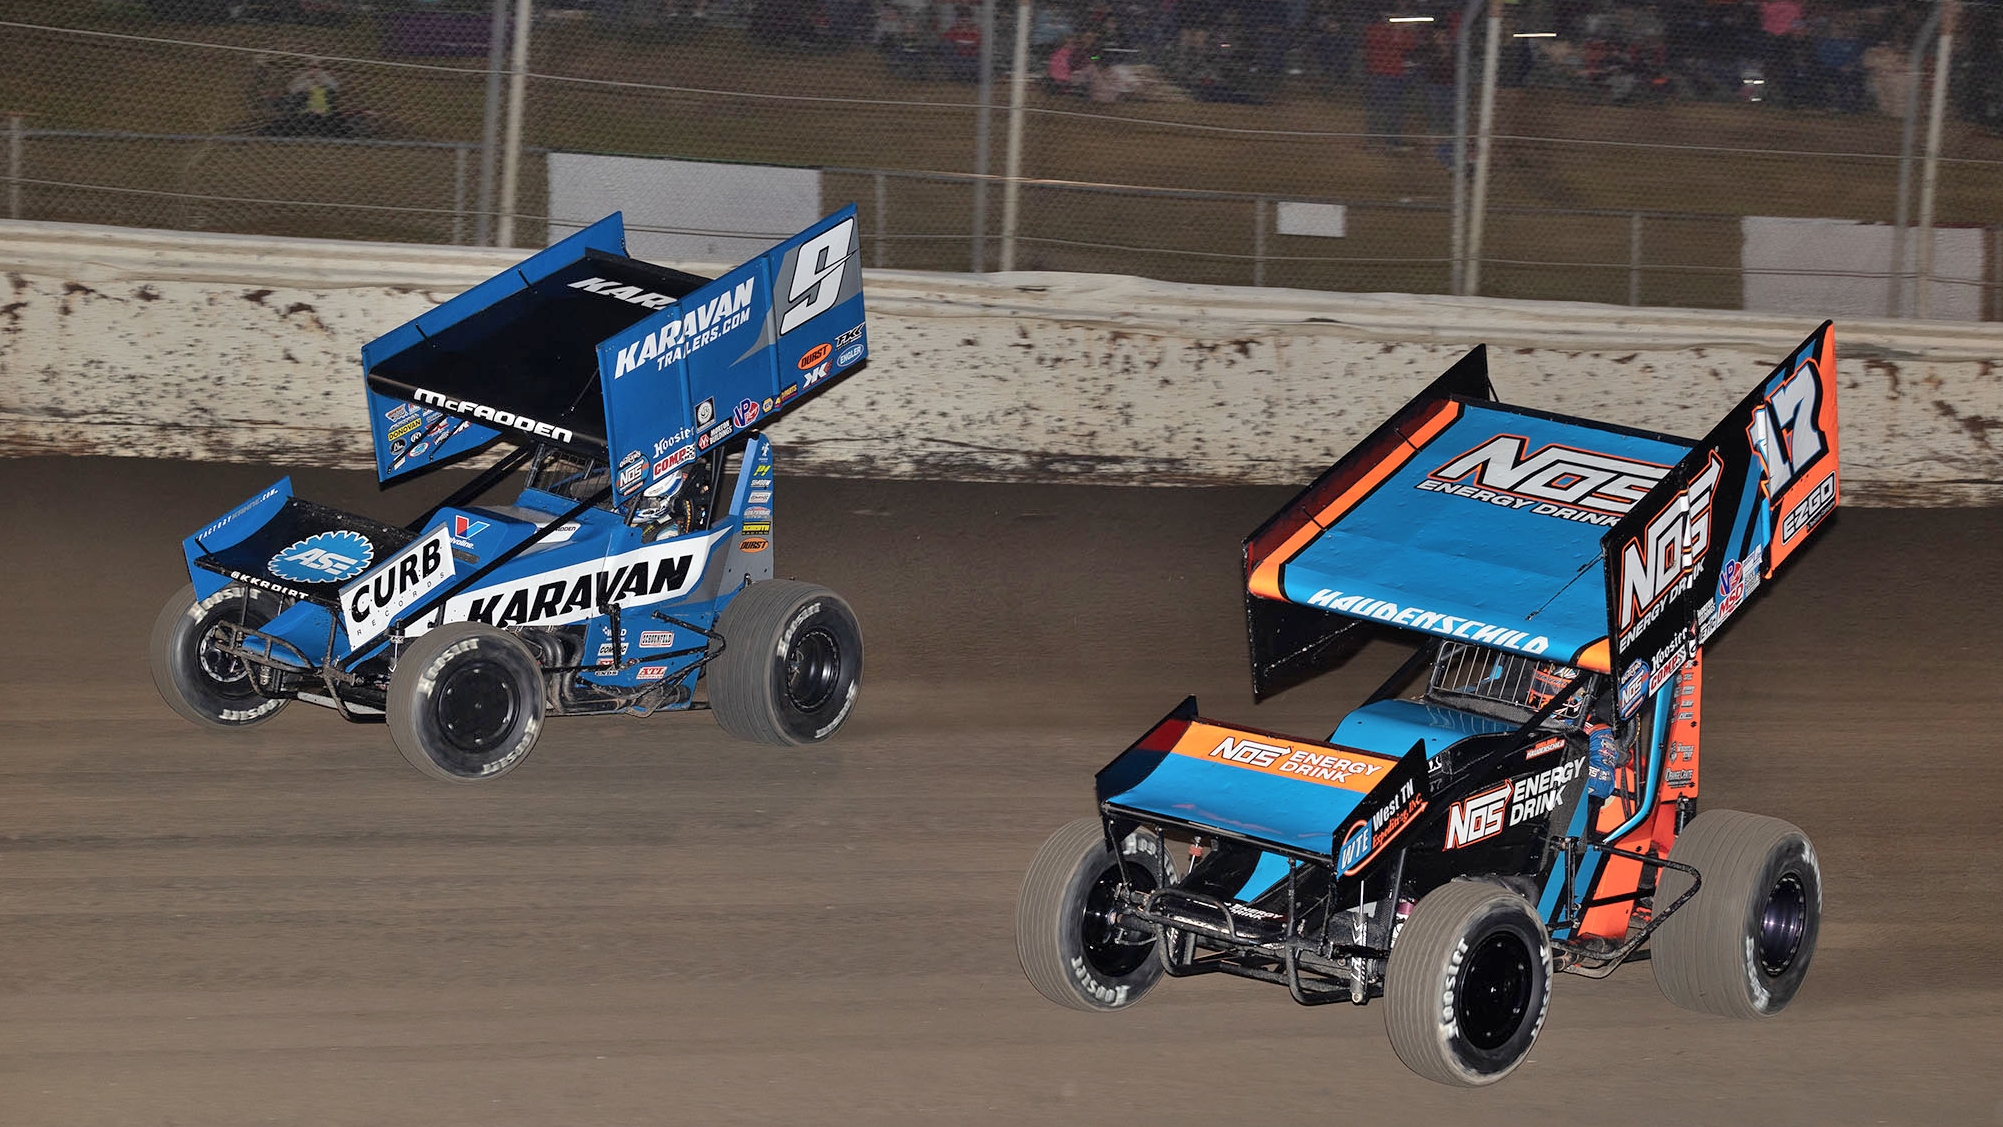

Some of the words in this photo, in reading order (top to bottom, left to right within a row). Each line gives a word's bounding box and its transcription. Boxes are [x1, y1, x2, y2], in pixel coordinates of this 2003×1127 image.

[780, 217, 854, 335] 9
[614, 277, 755, 380] KARAVAN
[657, 307, 750, 371] TRAILERS.COM
[801, 345, 829, 368] DURST
[839, 346, 861, 365] ENGLER
[389, 420, 420, 440] DONOVAN
[413, 388, 573, 444] McFADDEN
[1750, 363, 1822, 498] 17
[653, 426, 694, 459] Hoosier
[654, 447, 686, 477] COMP
[619, 459, 643, 487] NOS
[1438, 437, 1668, 513] NOS
[1416, 480, 1532, 509] ENERGY
[1532, 504, 1621, 527] DRINK
[740, 541, 768, 549] DURST
[1622, 457, 1721, 629] NOS
[230, 571, 309, 600] @KKRDIRT
[351, 538, 441, 623] CURB
[357, 572, 445, 635] RECORDS
[466, 553, 694, 627] KARAVAN
[1719, 583, 1743, 618] MSD
[1307, 588, 1550, 655] HAUDENSCHILD
[1619, 597, 1667, 654] ENERGY
[640, 667, 665, 675] ATL
[1650, 626, 1688, 674] Hoosier
[1650, 654, 1679, 691] COMP
[1621, 669, 1644, 707] NOS
[1209, 736, 1292, 768] NOS
[1290, 750, 1383, 776] ENERGY
[1278, 760, 1352, 783] DRINK
[1513, 757, 1586, 803] ENERGY
[1373, 794, 1400, 831] West
[1401, 778, 1414, 804] TN
[1447, 783, 1512, 850] NOS
[1510, 785, 1566, 826] DRINK
[1341, 828, 1369, 869] WTE
